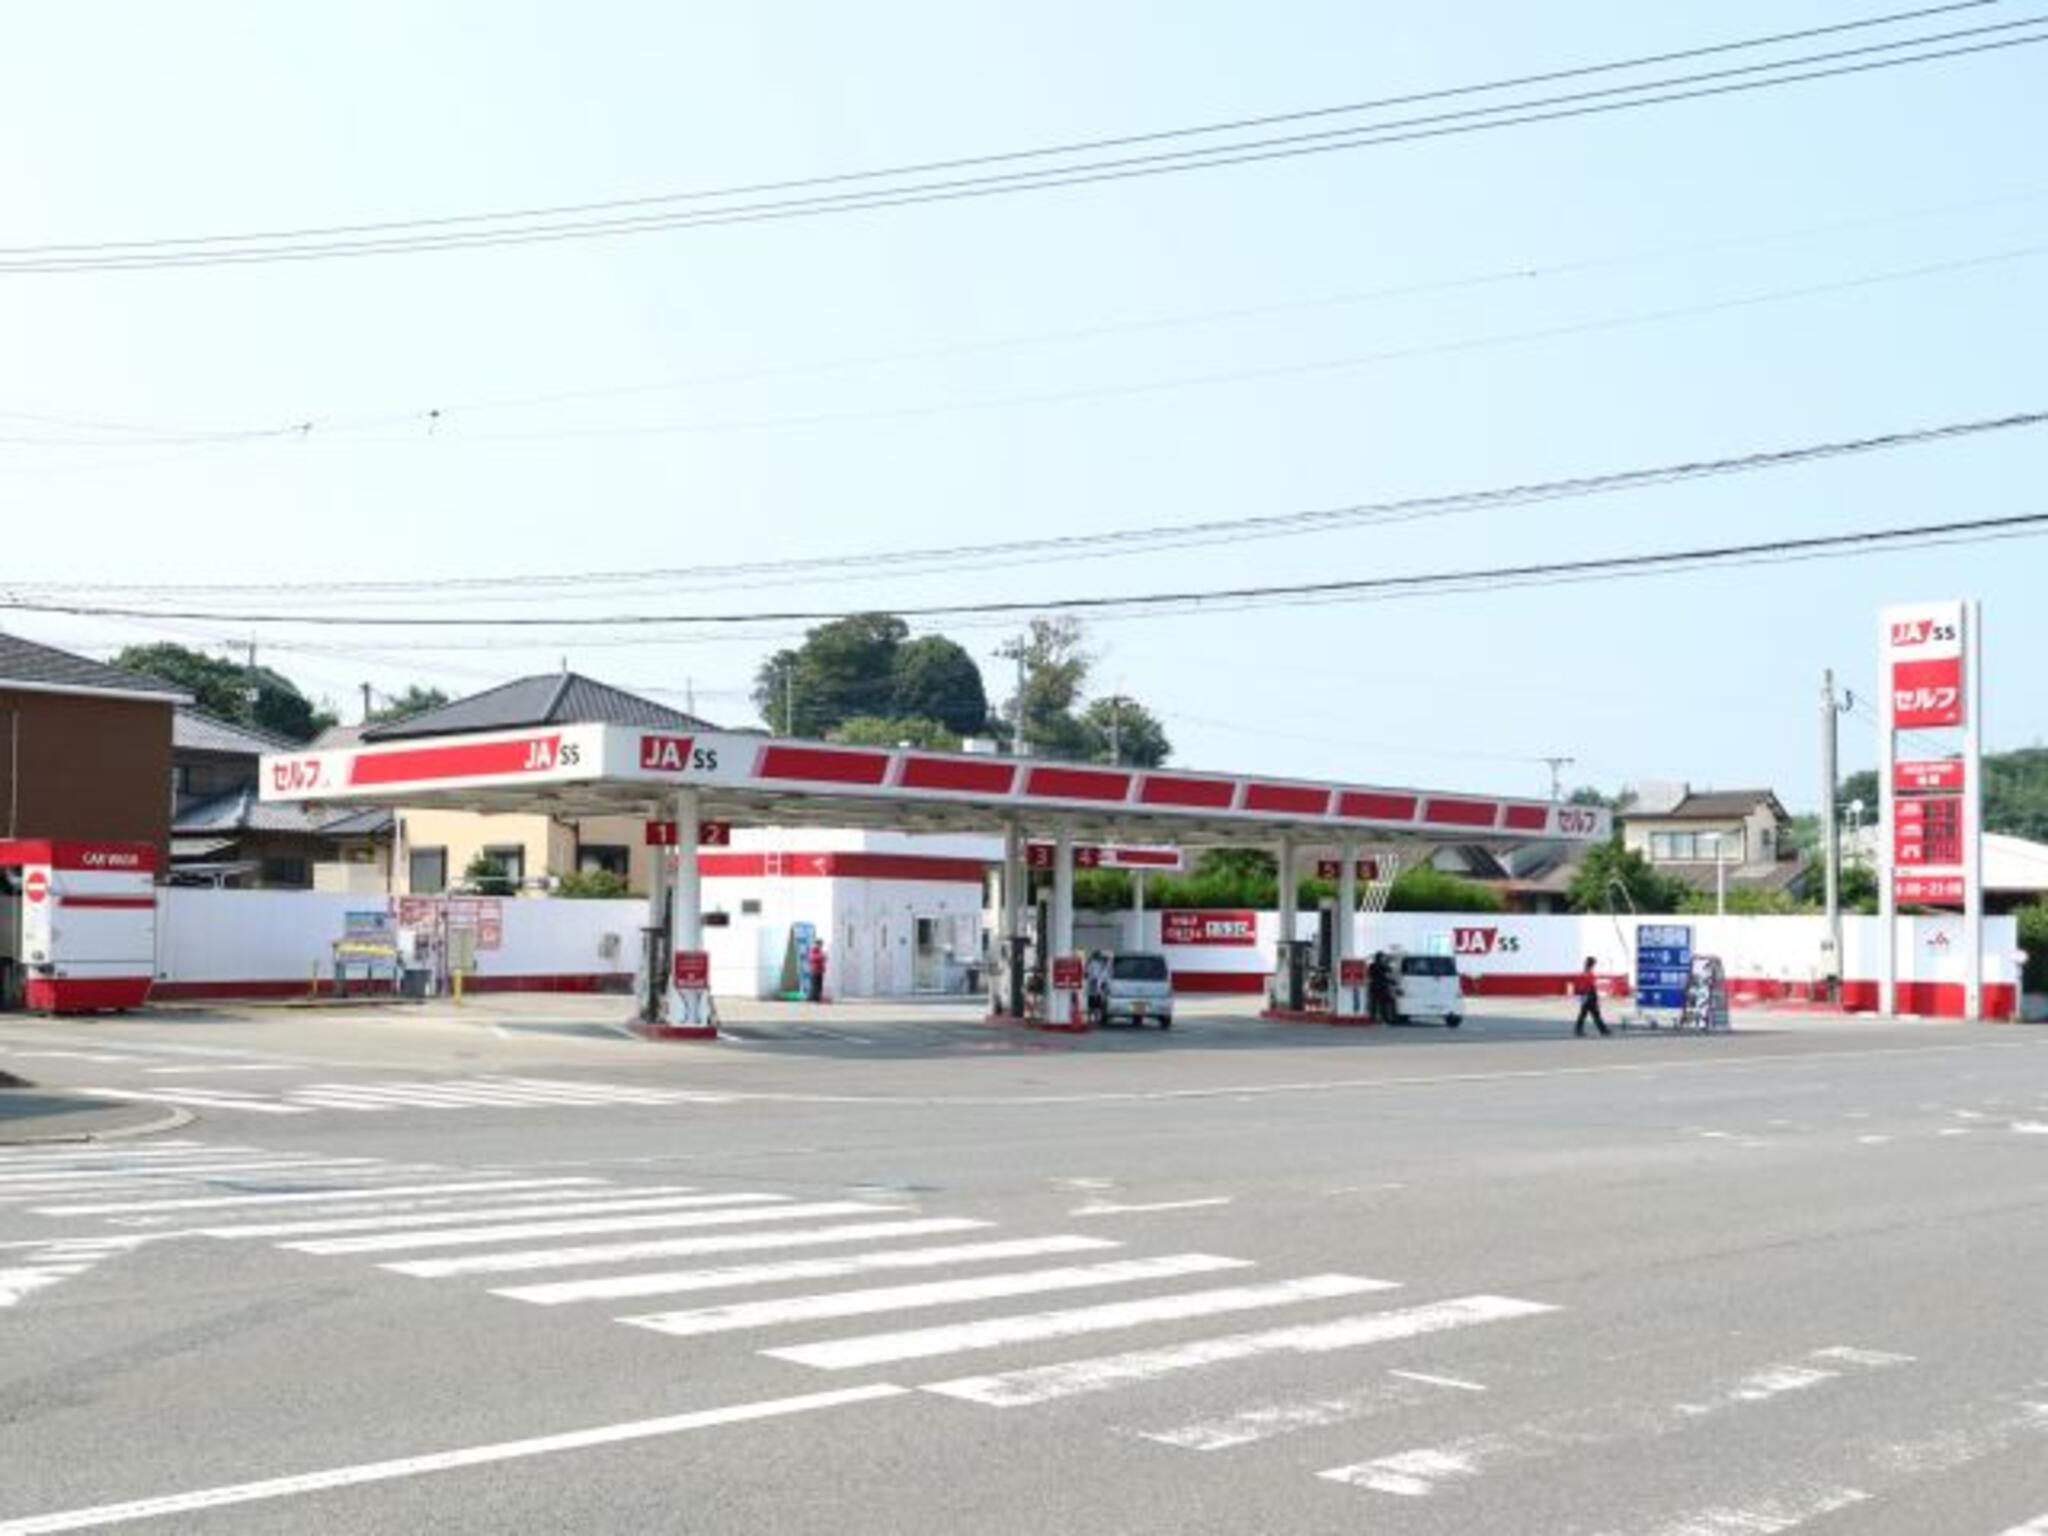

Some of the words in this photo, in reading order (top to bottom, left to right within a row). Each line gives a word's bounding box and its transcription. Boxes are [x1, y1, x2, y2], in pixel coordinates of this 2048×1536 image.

[1895, 623, 1921, 642] JA
[1895, 687, 1956, 711] セルフ
[524, 741, 553, 769] JA
[644, 738, 682, 768] JA
[272, 760, 322, 791] セルフ
[1558, 808, 1596, 833] セルフ
[707, 825, 721, 844] 2
[1036, 848, 1047, 867] 3
[1078, 849, 1093, 865] 4
[1457, 930, 1486, 952] JA
